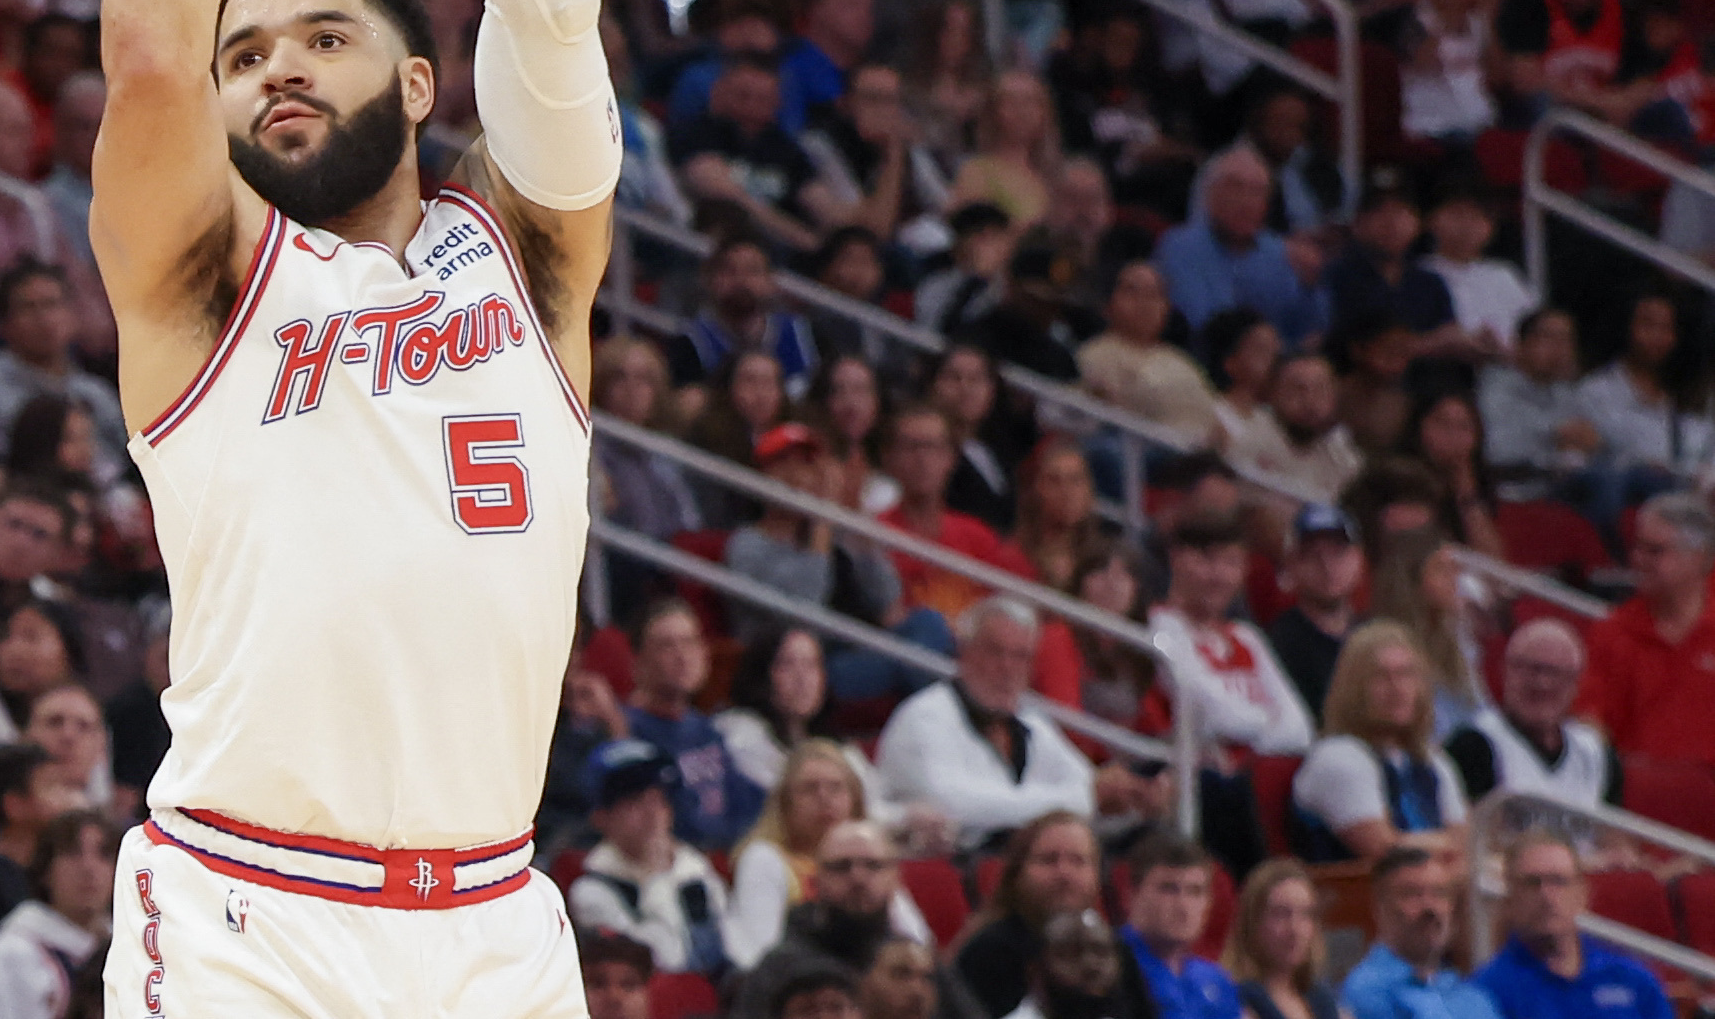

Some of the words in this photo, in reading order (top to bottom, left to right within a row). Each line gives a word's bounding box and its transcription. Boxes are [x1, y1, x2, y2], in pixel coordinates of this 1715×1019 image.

[419, 223, 479, 268] redit
[436, 241, 494, 282] arma
[261, 290, 525, 426] H-Town
[442, 413, 534, 535] 5
[135, 868, 166, 1019] ROC
